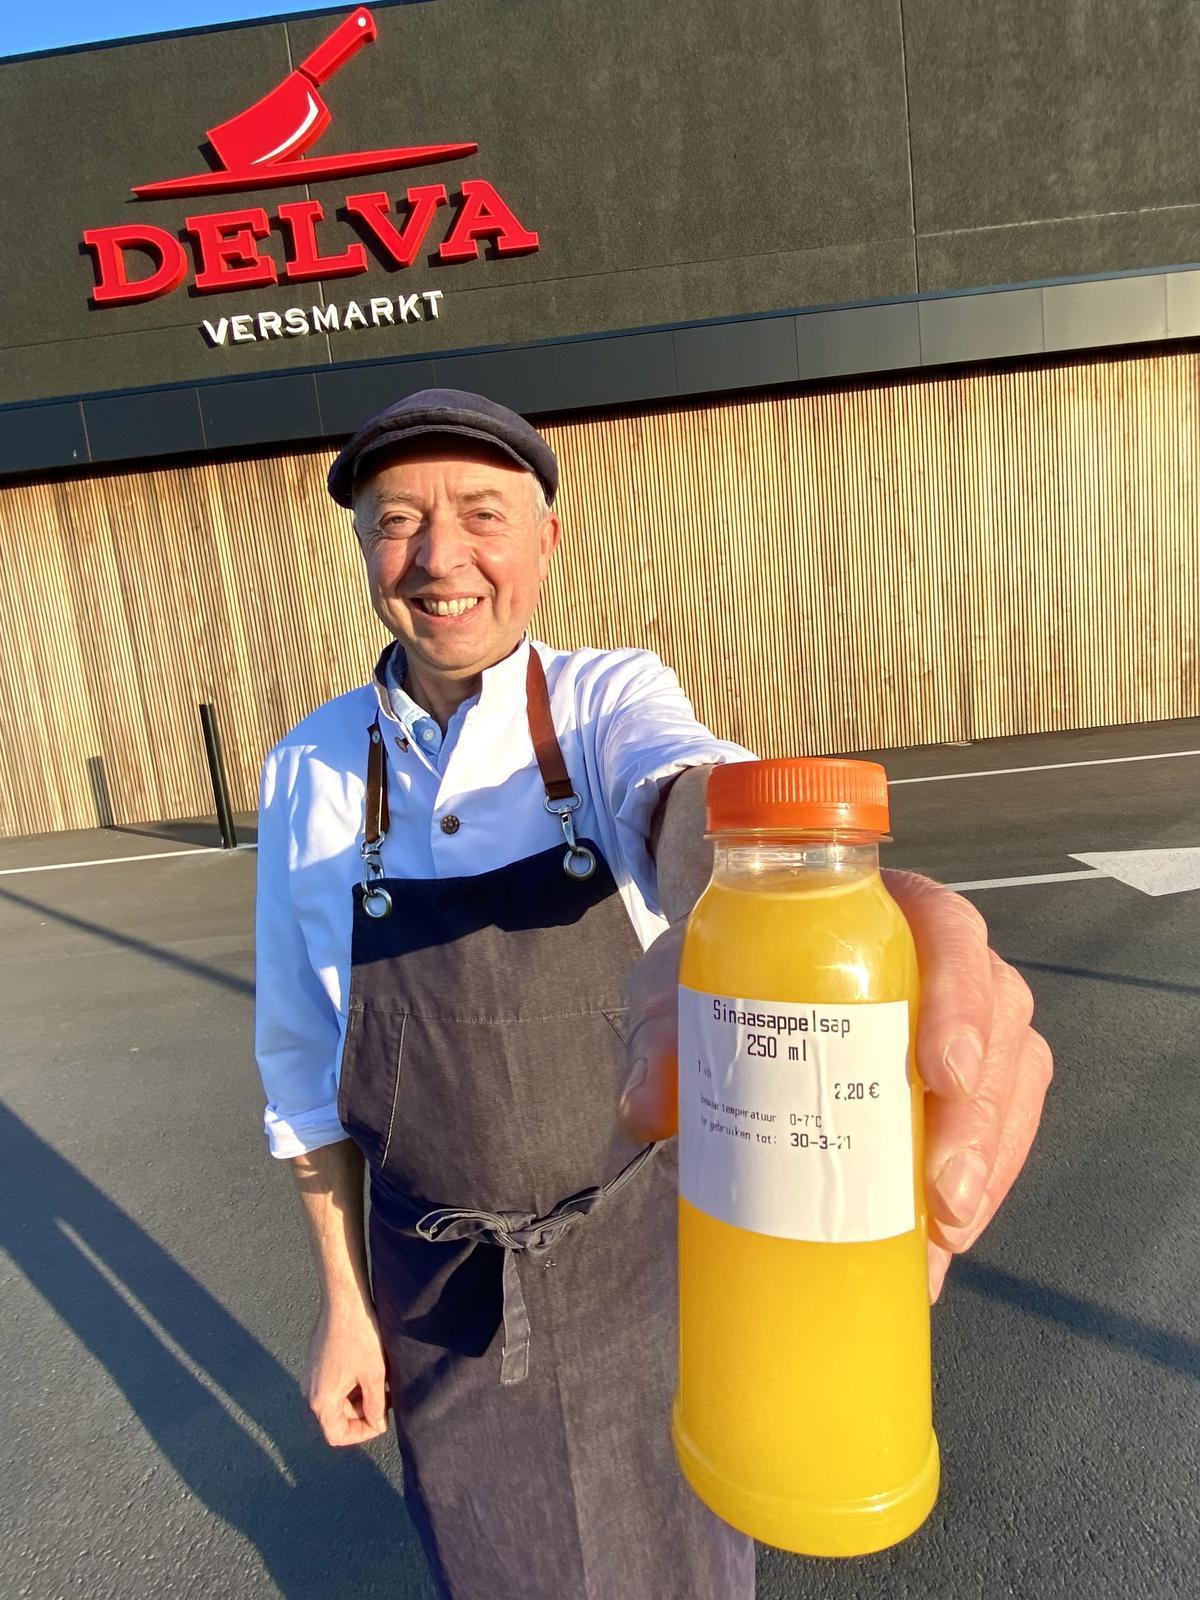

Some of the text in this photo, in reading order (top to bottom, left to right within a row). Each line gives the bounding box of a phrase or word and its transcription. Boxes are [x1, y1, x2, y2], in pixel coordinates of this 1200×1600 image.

[83, 179, 540, 301] DELVA
[202, 290, 444, 346] VERSMARKT
[713, 999, 851, 1038] Sinaasappelsap
[747, 1034, 808, 1061] 250 ml
[756, 1133, 777, 1145] tot:
